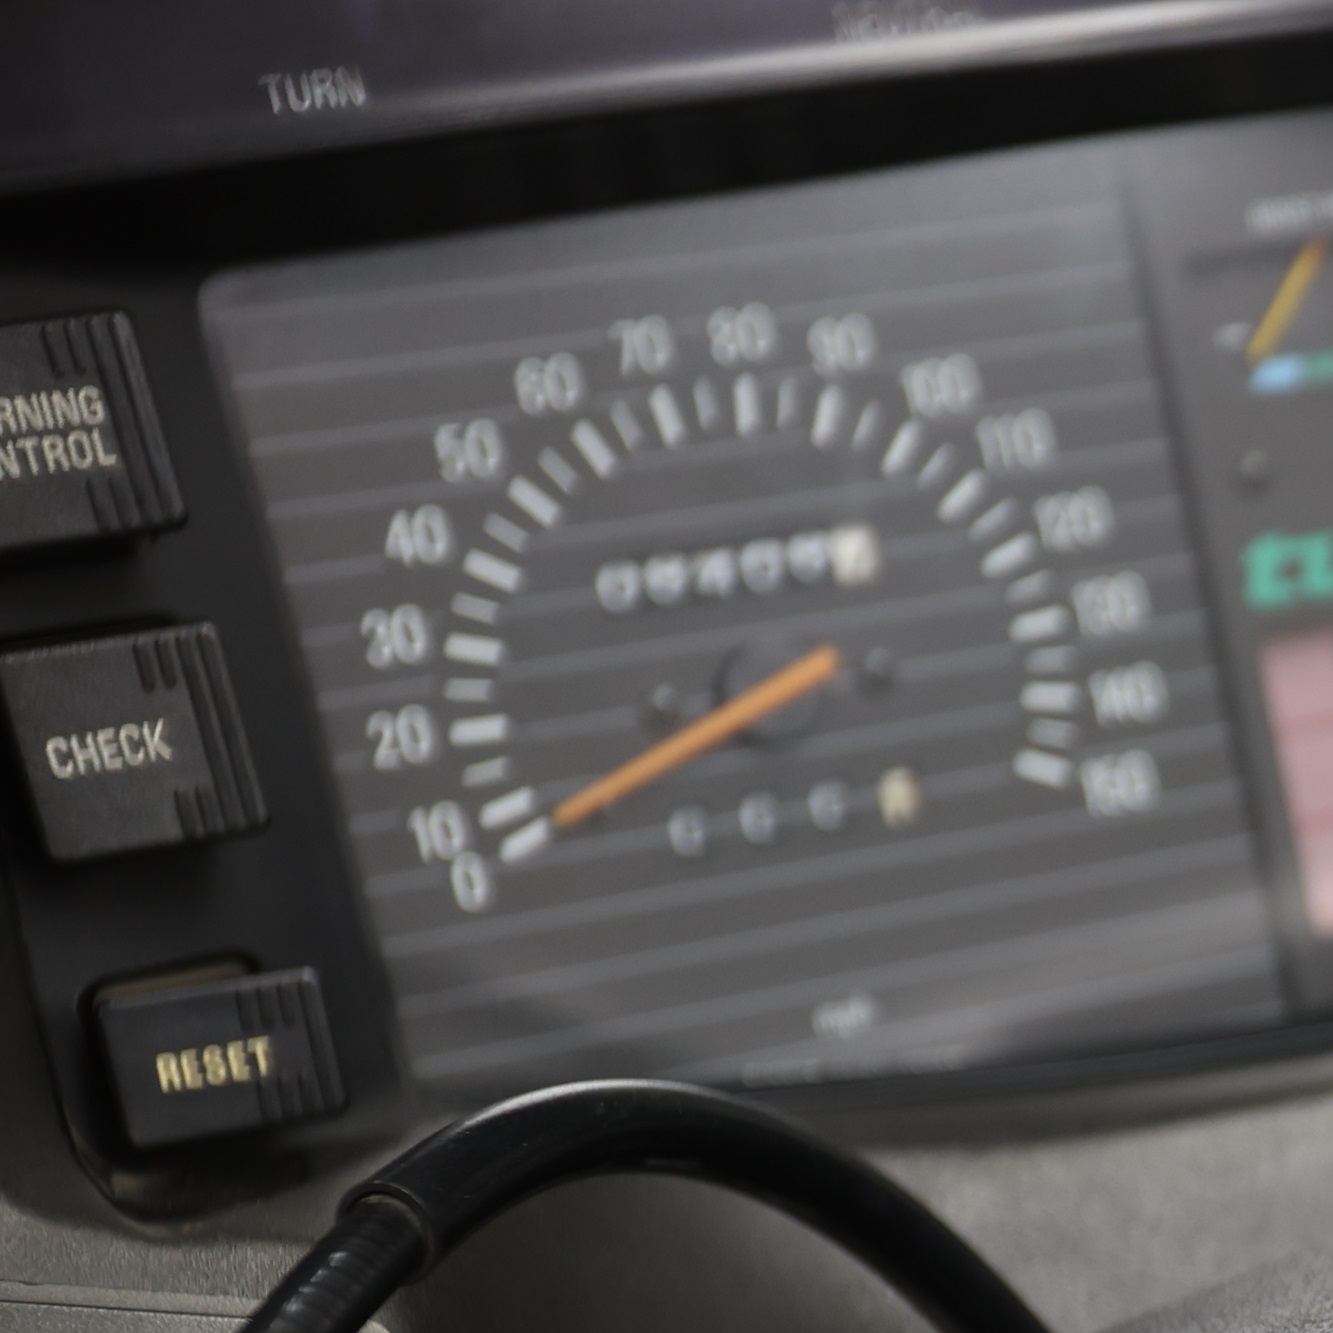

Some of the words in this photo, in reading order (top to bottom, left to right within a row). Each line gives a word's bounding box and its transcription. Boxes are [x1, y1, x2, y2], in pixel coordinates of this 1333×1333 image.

[259, 66, 366, 115] TURN
[608, 314, 674, 376] 70
[0, 385, 105, 437] RNING
[434, 418, 501, 483] 50
[385, 504, 454, 566] 40
[361, 604, 427, 668] 30
[46, 718, 173, 779] CHECK
[366, 704, 433, 770] 20
[409, 800, 469, 863] 10
[450, 851, 492, 913] 0
[156, 1035, 273, 1093] RESET
